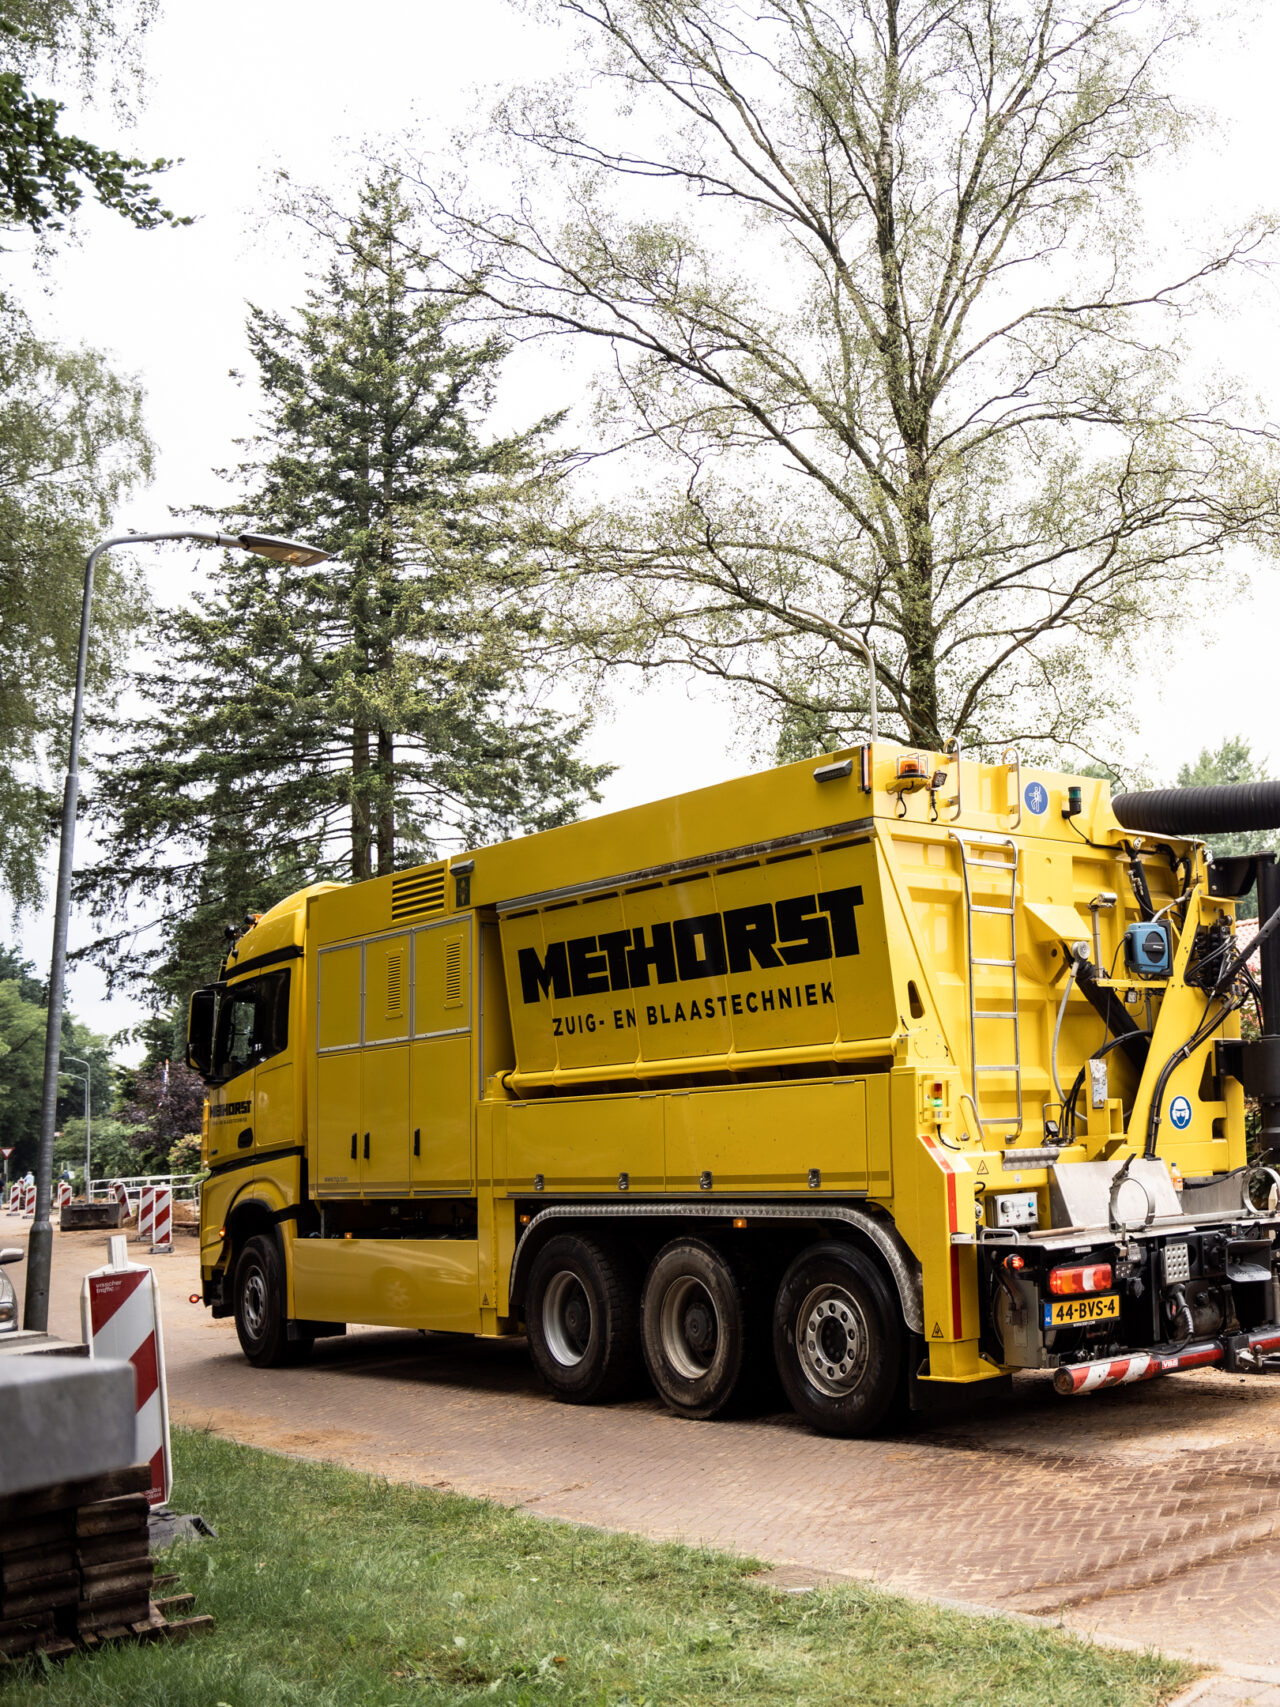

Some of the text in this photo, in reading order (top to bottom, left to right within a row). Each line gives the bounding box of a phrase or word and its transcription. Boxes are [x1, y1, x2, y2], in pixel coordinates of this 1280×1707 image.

[517, 885, 865, 1004] METHORST
[552, 981, 836, 1037] ZUIG- EN BLAASTECHNIEK
[1056, 1298, 1116, 1322] 44-BVS-4
